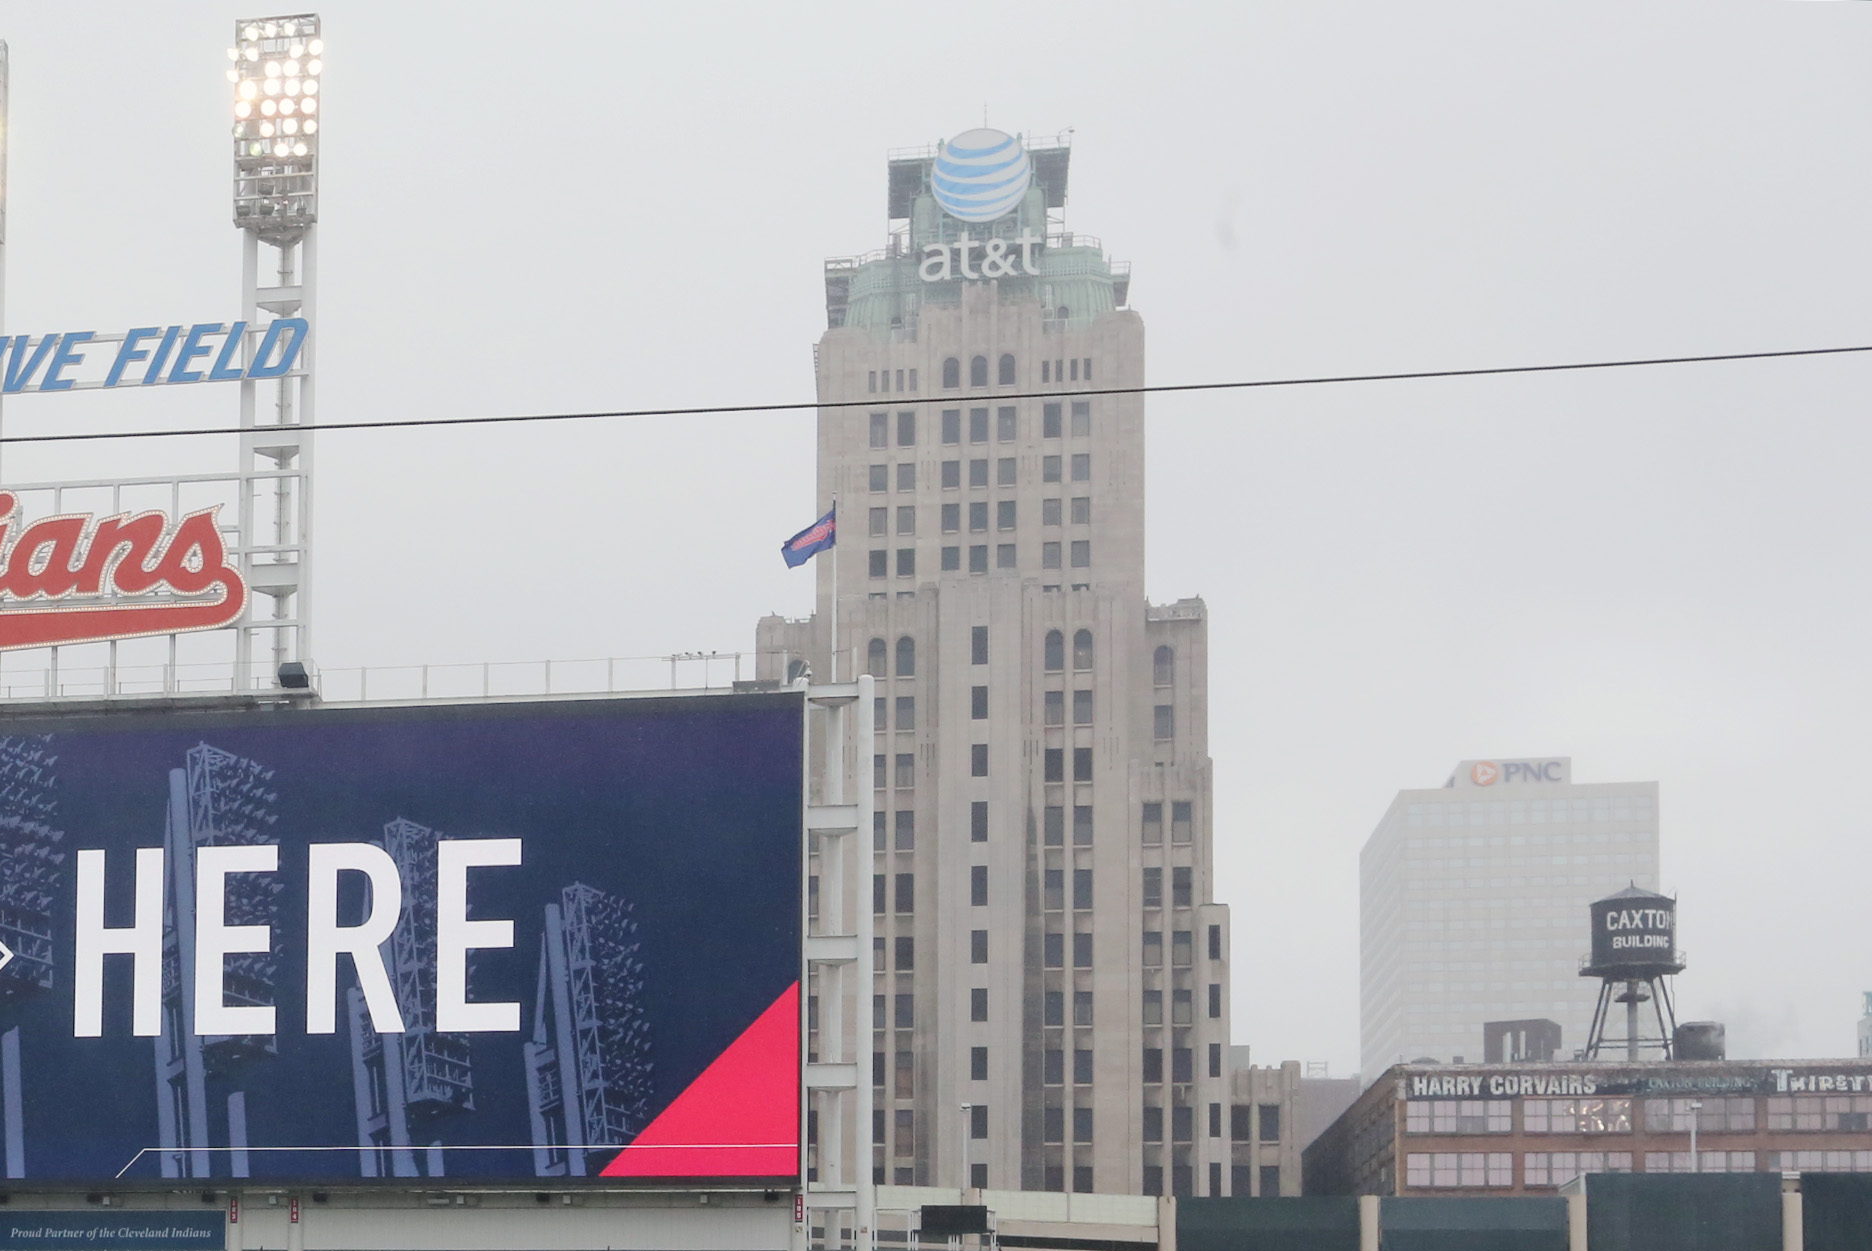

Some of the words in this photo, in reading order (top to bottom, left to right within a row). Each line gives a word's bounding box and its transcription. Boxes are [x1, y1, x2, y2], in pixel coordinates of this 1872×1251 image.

[918, 227, 1042, 282] at&t
[104, 317, 309, 388] FIELD
[1502, 761, 1562, 783] PNC
[73, 838, 523, 1036] HERE
[1613, 935, 1669, 949] BUILDING
[1412, 1075, 1483, 1096] HARRY
[1489, 1074, 1597, 1095] CORVAIRS
[10, 1227, 42, 1239] Proud
[44, 1227, 80, 1239] Partner
[81, 1227, 98, 1242] of
[99, 1227, 116, 1239] the
[117, 1227, 169, 1240] Cleveland
[170, 1227, 212, 1240] Indians
